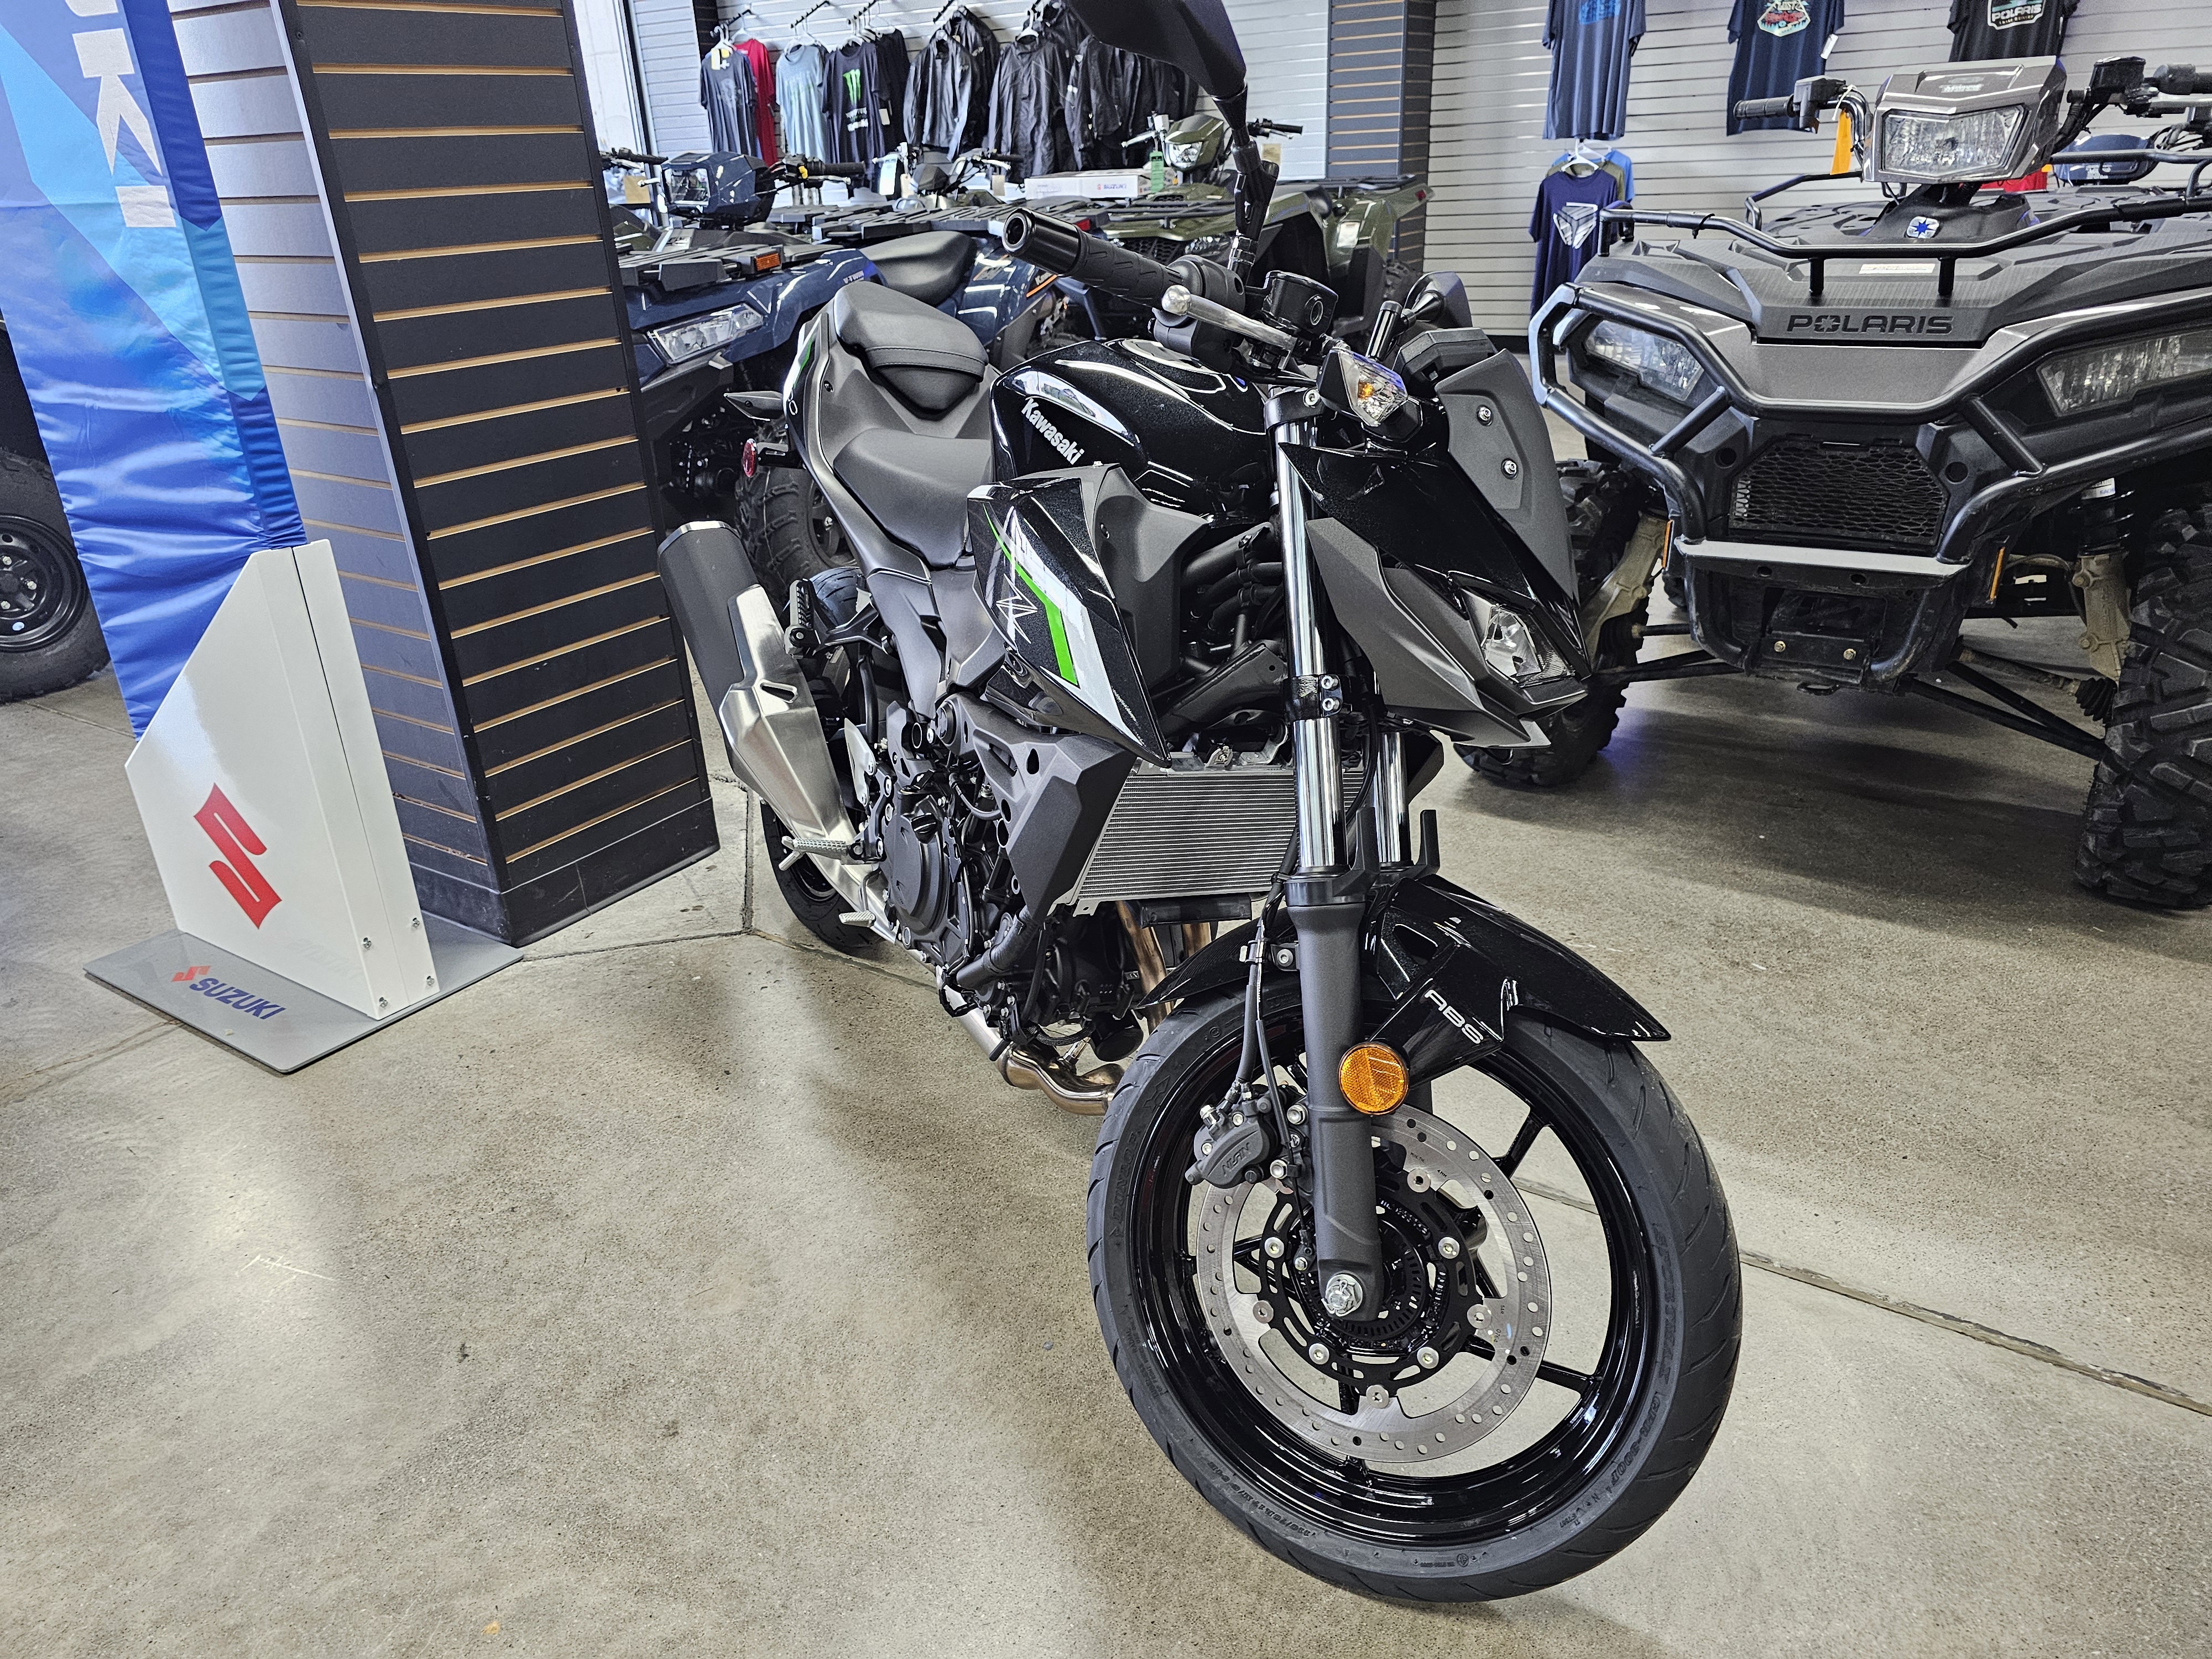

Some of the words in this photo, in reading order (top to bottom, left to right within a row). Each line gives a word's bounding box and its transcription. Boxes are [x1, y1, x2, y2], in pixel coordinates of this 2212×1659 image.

[1992, 4, 2042, 22] POLARIS
[1787, 315, 1954, 335] POLARIS
[1021, 398, 1085, 465] Kawasaki
[189, 978, 287, 1020] SUZUKI
[1424, 989, 1484, 1044] ABS
[1113, 1131, 1138, 1222] DUNLOP
